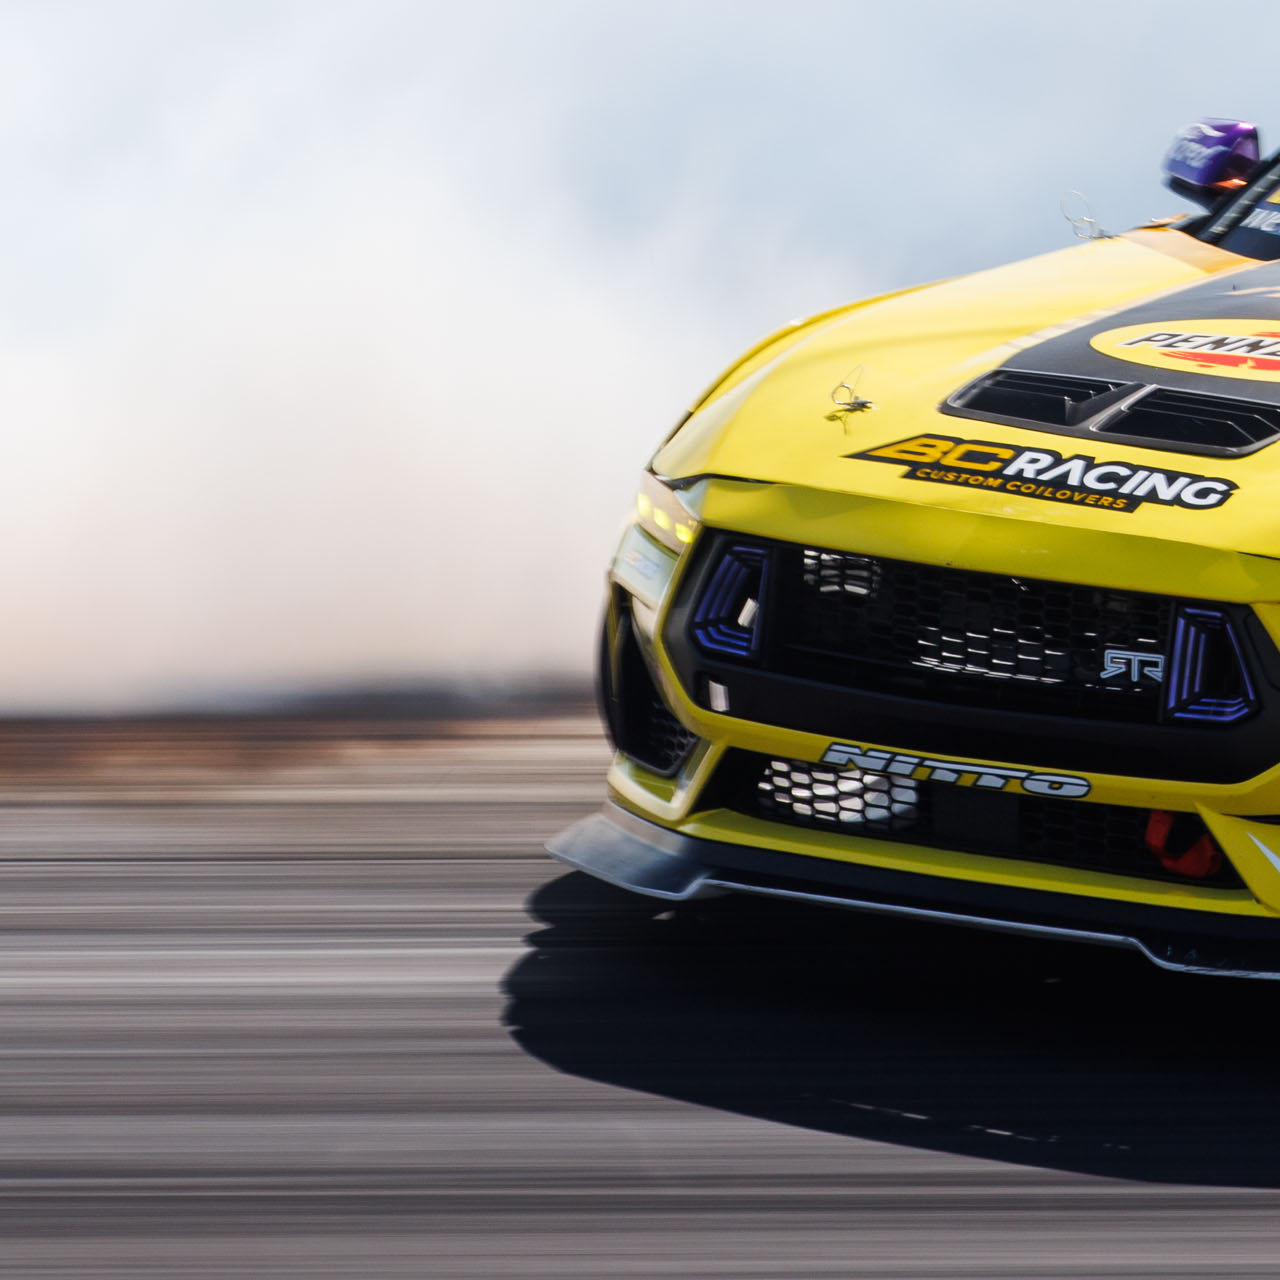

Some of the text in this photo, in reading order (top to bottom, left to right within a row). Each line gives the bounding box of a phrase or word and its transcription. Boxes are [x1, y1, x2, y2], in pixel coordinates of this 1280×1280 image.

[915, 468, 1129, 509] CUSTOM COILOVERS
[820, 742, 1092, 798] NITTO
